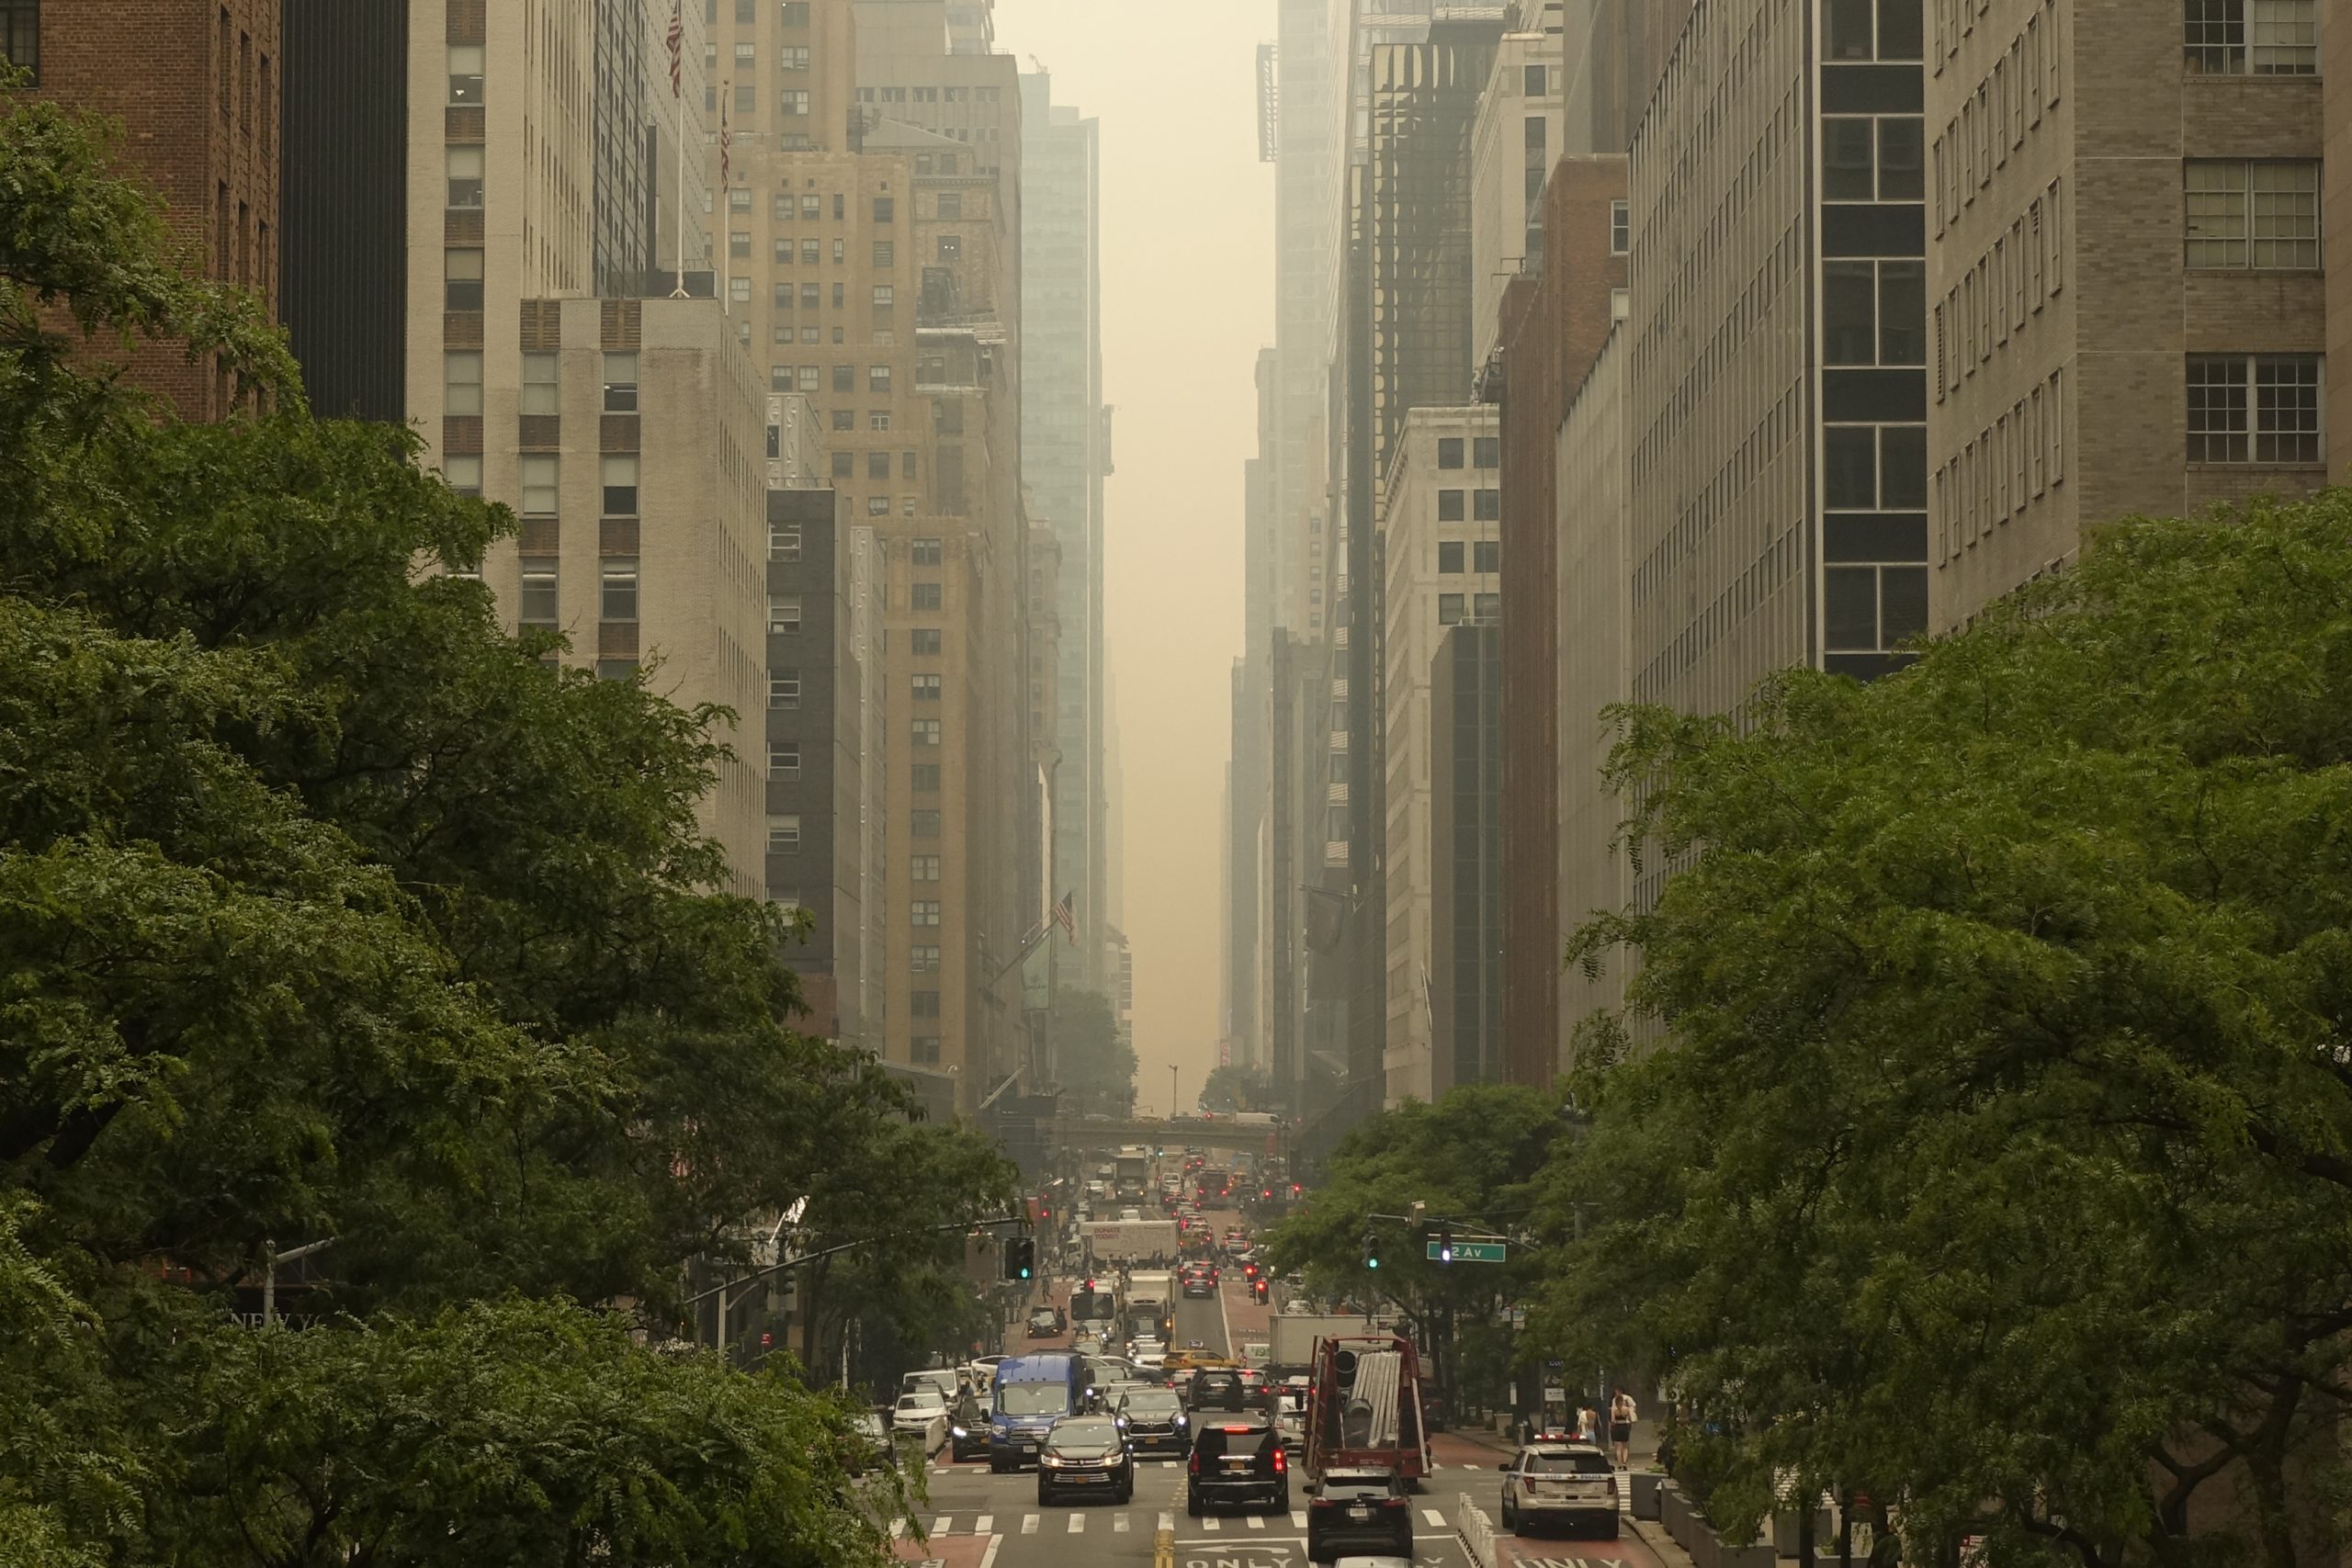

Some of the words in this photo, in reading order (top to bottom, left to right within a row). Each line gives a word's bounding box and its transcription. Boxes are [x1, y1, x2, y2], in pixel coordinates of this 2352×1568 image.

[1452, 1247, 1459, 1257] 2
[1464, 1247, 1481, 1258] Av
[1186, 1558, 1293, 1568] ONLY
